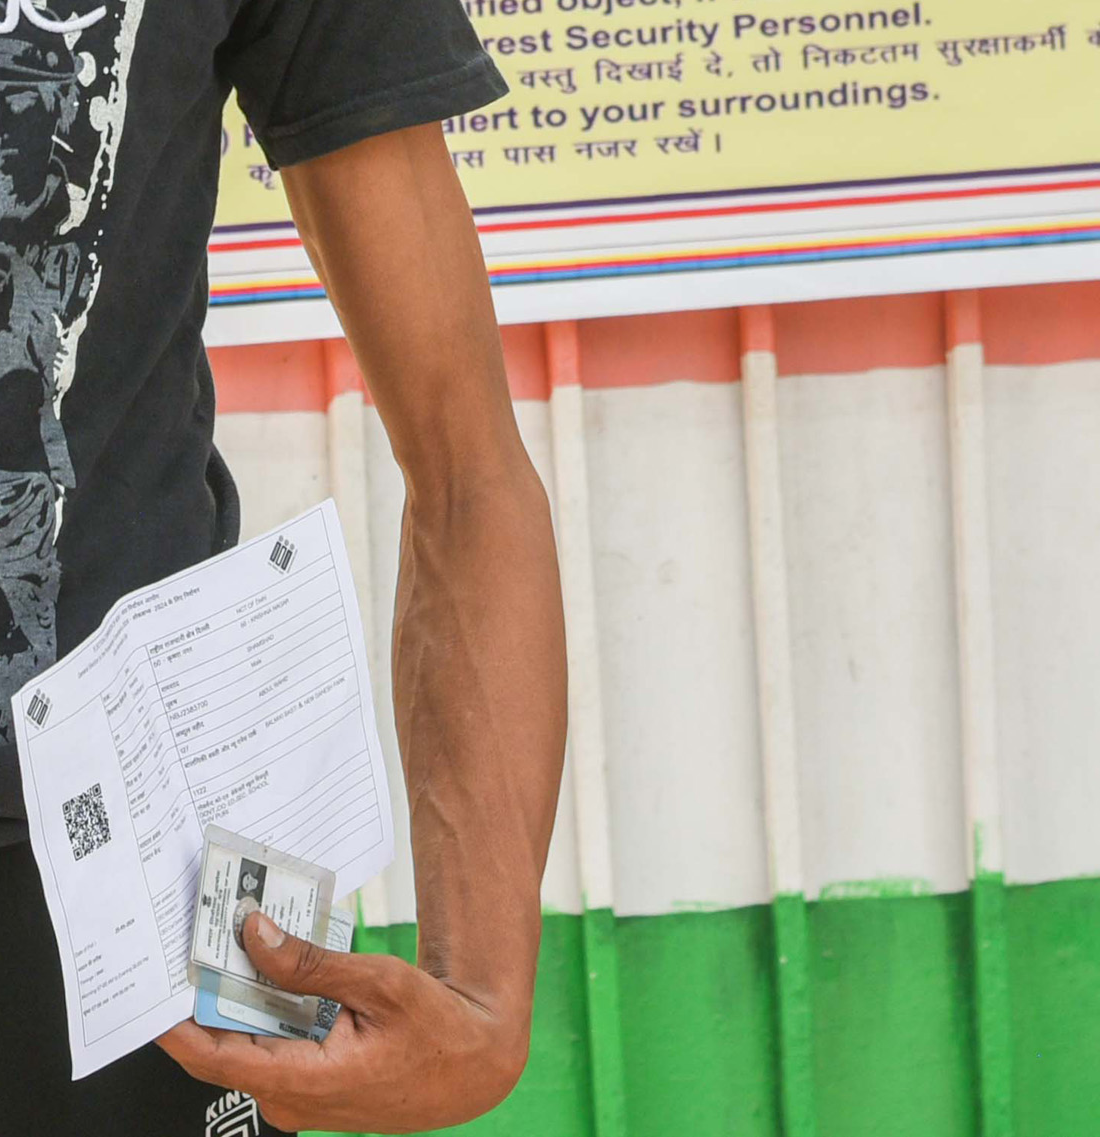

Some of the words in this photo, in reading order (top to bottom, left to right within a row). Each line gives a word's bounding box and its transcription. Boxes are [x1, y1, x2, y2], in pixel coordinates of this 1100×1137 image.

[484, 29, 554, 55] rest
[565, 16, 720, 52] Security
[732, 0, 932, 40] Personnel.
[751, 46, 782, 73] तो
[530, 104, 567, 130] to
[580, 100, 665, 133] your
[677, 78, 941, 119] surroundings.
[502, 142, 557, 165] पास
[205, 1089, 252, 1123] KIN
